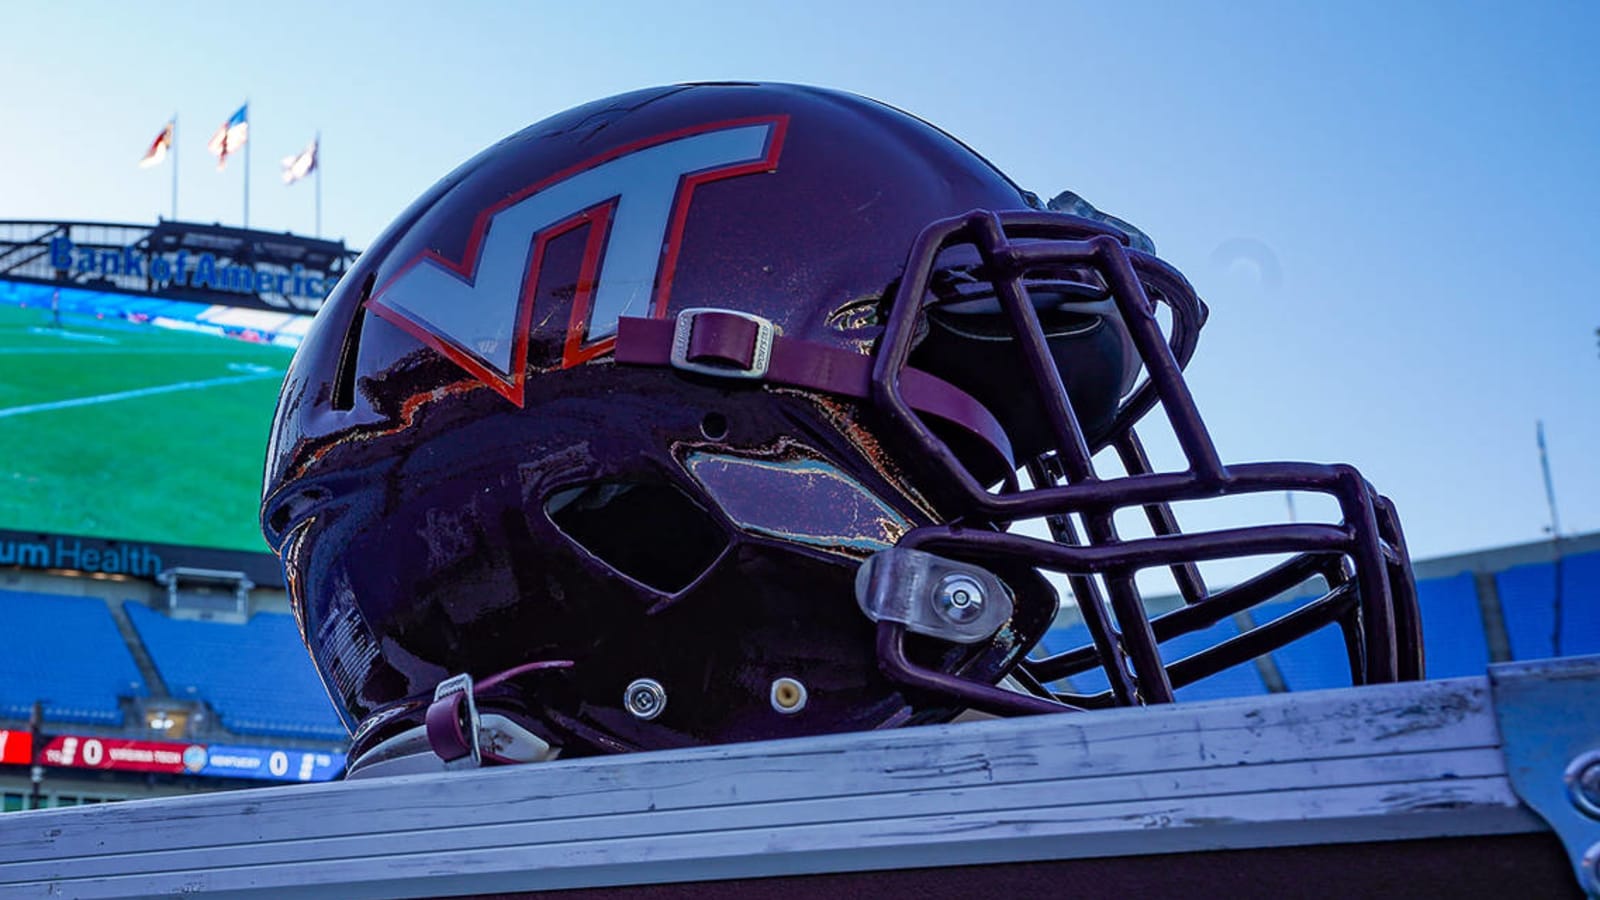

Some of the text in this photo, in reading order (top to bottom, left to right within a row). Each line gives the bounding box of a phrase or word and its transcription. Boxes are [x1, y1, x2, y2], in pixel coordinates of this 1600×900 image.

[50, 236, 143, 276] Bank
[150, 248, 191, 286] of
[55, 537, 161, 577] Health
[82, 739, 103, 766] 0
[269, 751, 288, 776] 0
